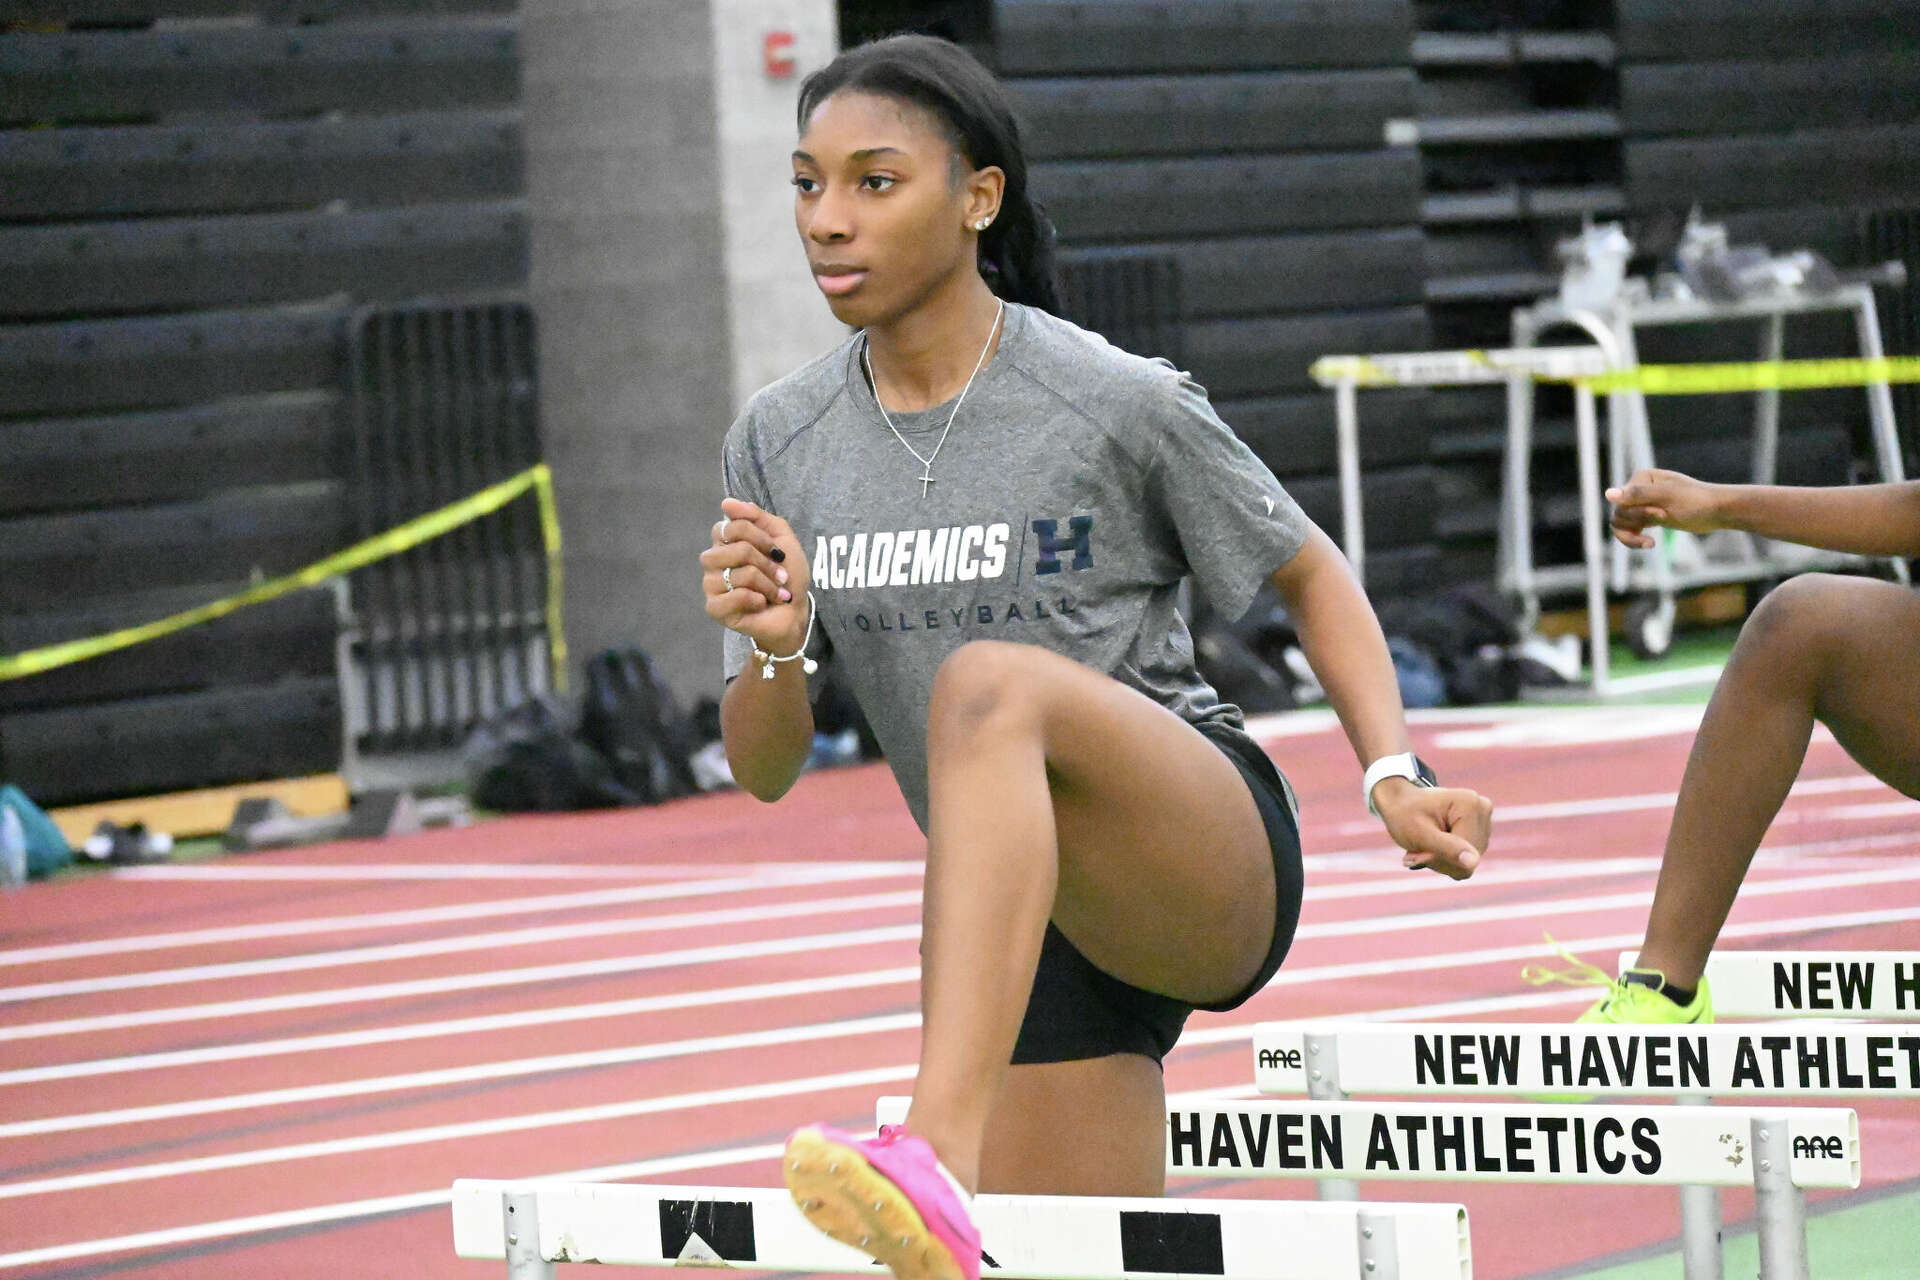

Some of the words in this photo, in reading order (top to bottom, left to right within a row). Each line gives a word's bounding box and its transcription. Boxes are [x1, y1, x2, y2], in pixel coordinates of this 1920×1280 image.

[812, 523, 1010, 590] ACADEMICS
[1032, 515, 1094, 575] H
[838, 597, 1076, 633] VOLLEYBALL
[1773, 962, 1875, 1010] NEW
[1414, 1034, 1521, 1086] NEW
[1541, 1035, 1711, 1087] HAVEN
[1170, 1112, 1344, 1169] HAVEN
[1365, 1113, 1662, 1176] ATHLETICS
